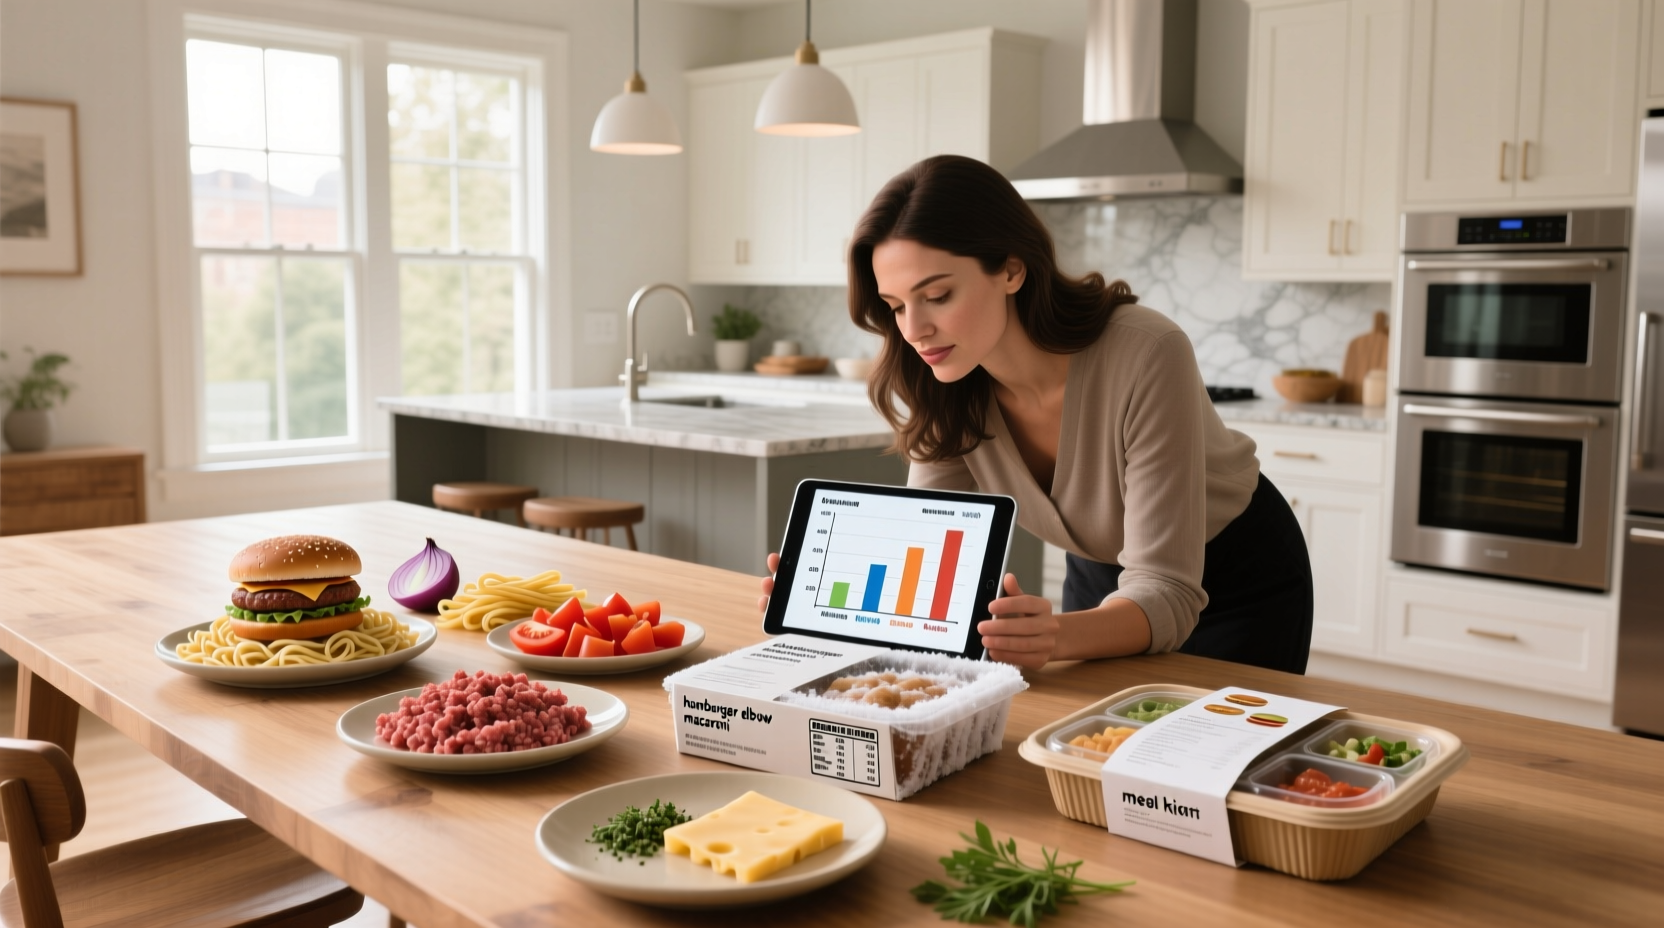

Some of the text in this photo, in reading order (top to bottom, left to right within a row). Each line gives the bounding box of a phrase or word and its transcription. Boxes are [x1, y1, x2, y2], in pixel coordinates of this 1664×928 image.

[683, 714, 730, 732] macaroni
[741, 706, 773, 725] elbow
[1122, 791, 1159, 810] meal
